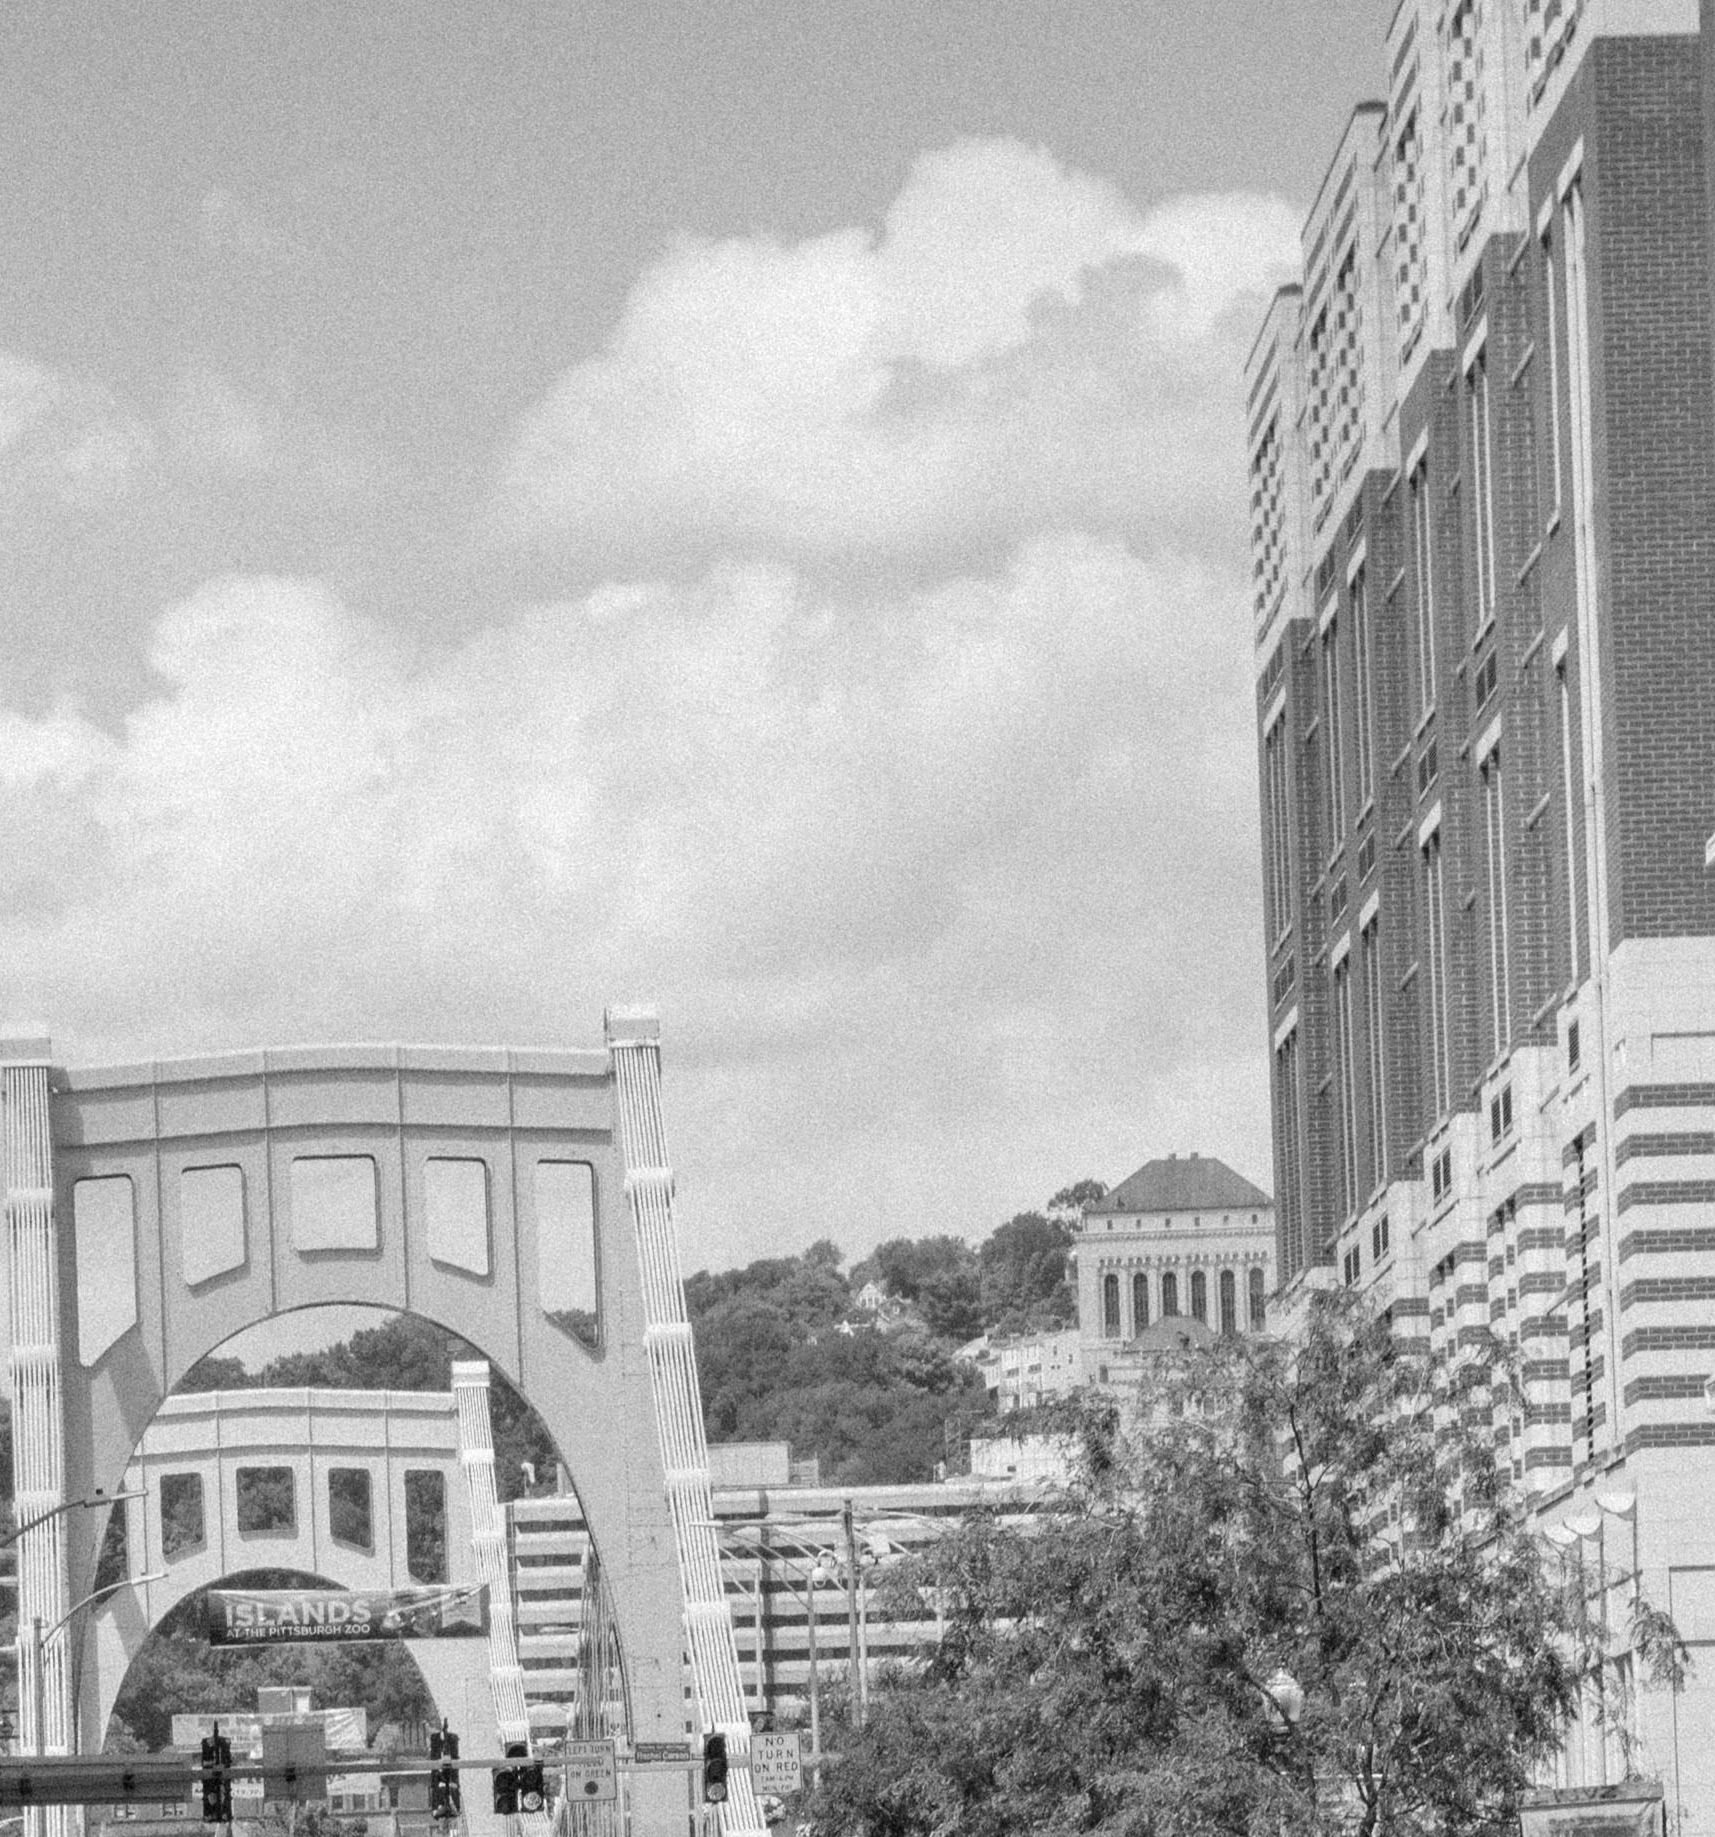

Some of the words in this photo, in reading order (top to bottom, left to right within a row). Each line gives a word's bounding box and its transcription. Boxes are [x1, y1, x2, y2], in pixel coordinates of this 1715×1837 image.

[225, 1599, 372, 1627] ISLANDS
[226, 1629, 241, 1638] AT
[244, 1628, 266, 1638] THE
[269, 1625, 341, 1637] PITTSBURGH
[344, 1623, 371, 1634] ZOO
[766, 1736, 785, 1746] NO
[758, 1749, 794, 1760] TURN
[754, 1763, 770, 1773] ON
[776, 1761, 798, 1771] RED
